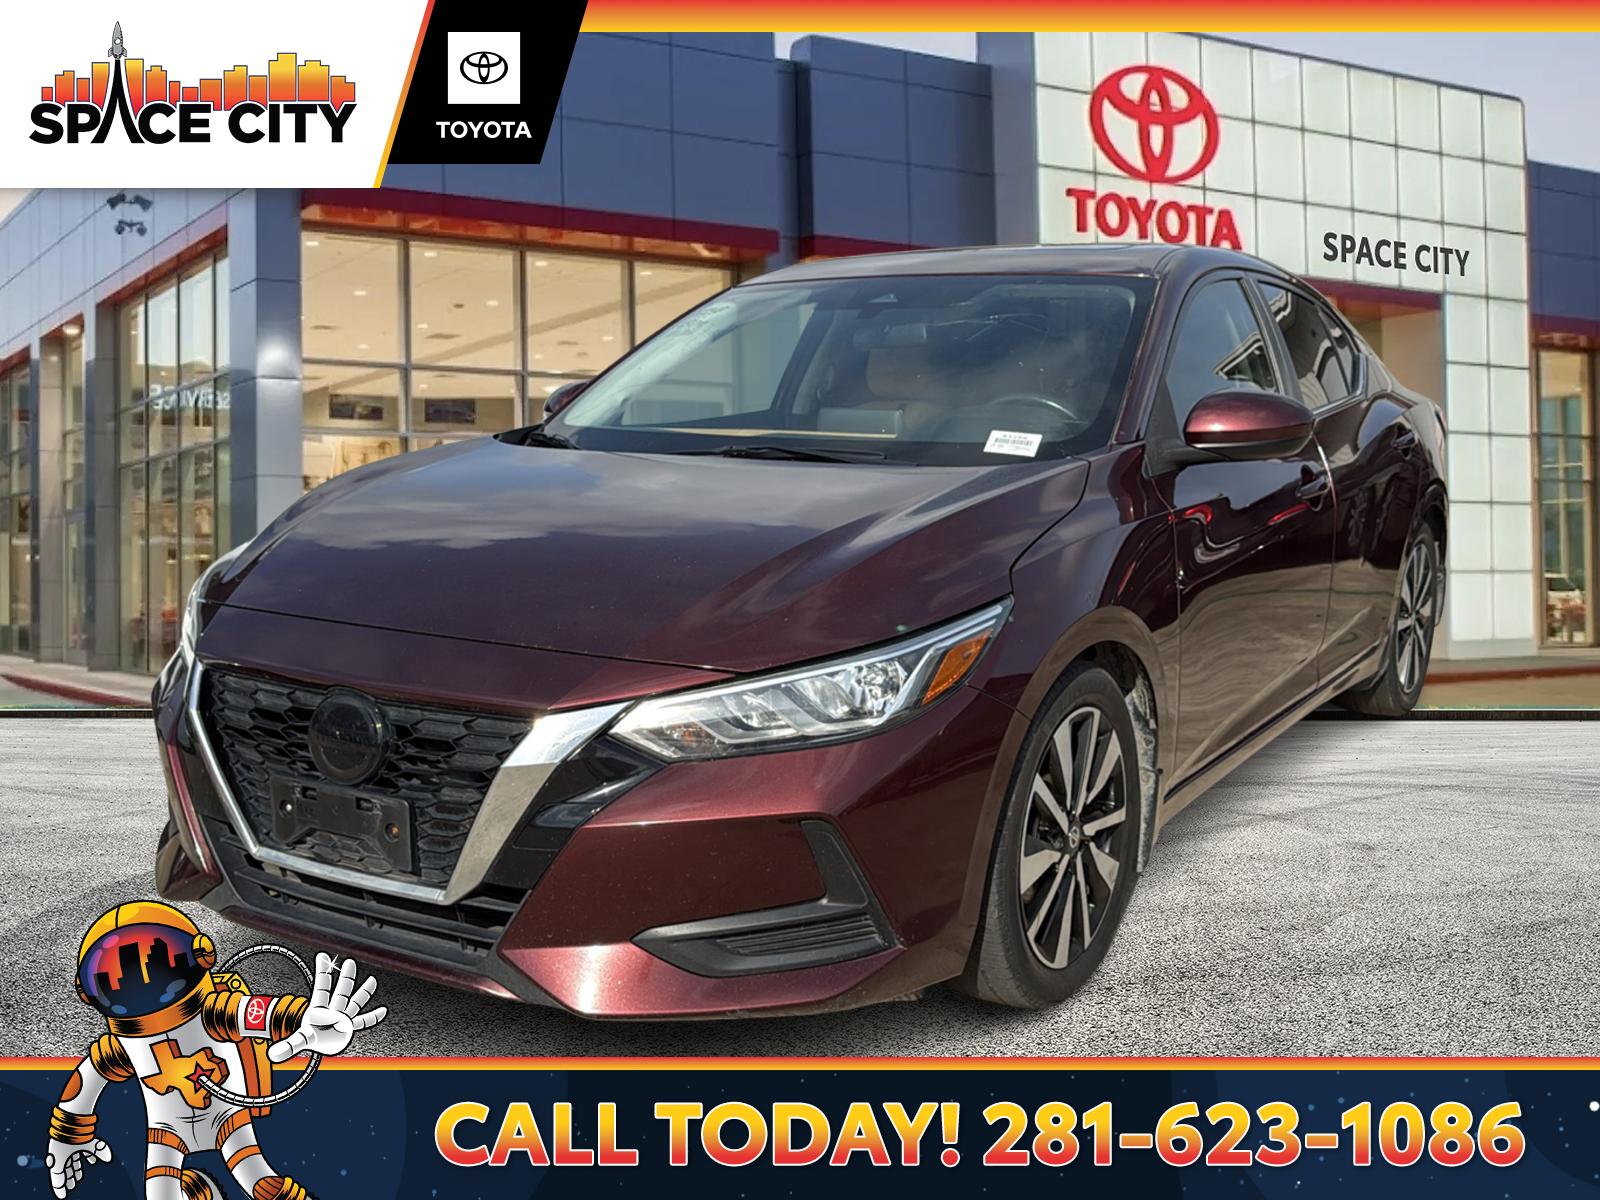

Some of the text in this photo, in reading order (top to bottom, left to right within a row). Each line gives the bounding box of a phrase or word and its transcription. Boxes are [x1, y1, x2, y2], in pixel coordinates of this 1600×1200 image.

[1066, 188, 1242, 250] TOYOTA
[1323, 232, 1470, 276] SPACE CITY
